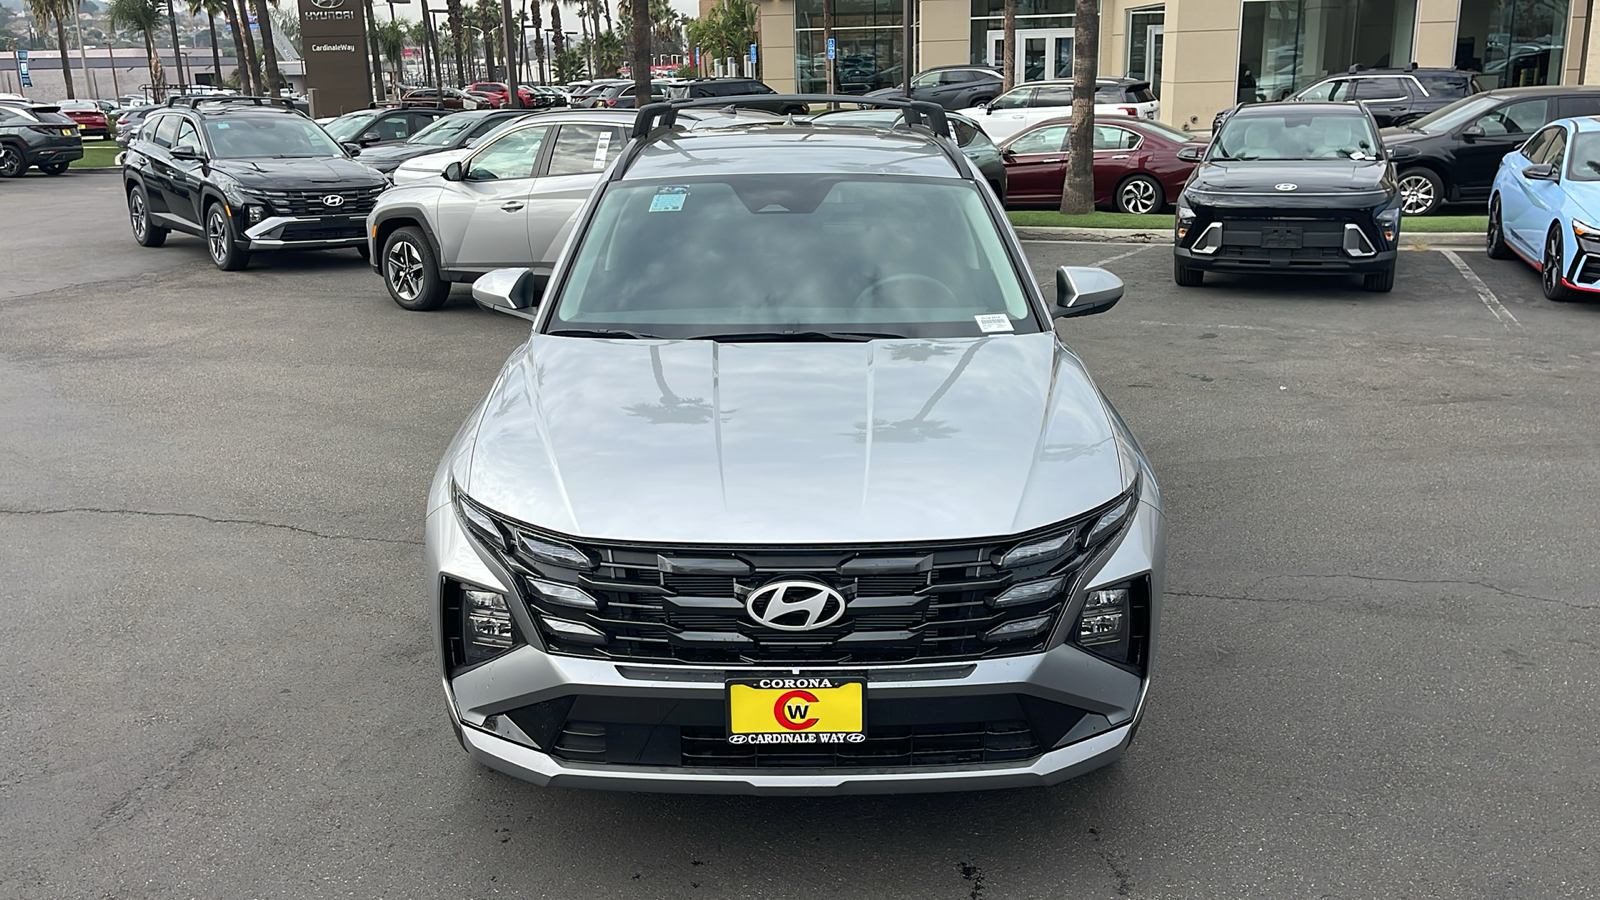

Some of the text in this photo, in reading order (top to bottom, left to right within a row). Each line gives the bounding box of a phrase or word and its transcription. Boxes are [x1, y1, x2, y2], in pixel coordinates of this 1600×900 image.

[305, 11, 354, 20] HYUNDAI
[312, 44, 355, 52] CardinaleWay
[759, 678, 833, 689] CORONA
[748, 733, 847, 744] CARDINALE WAY
